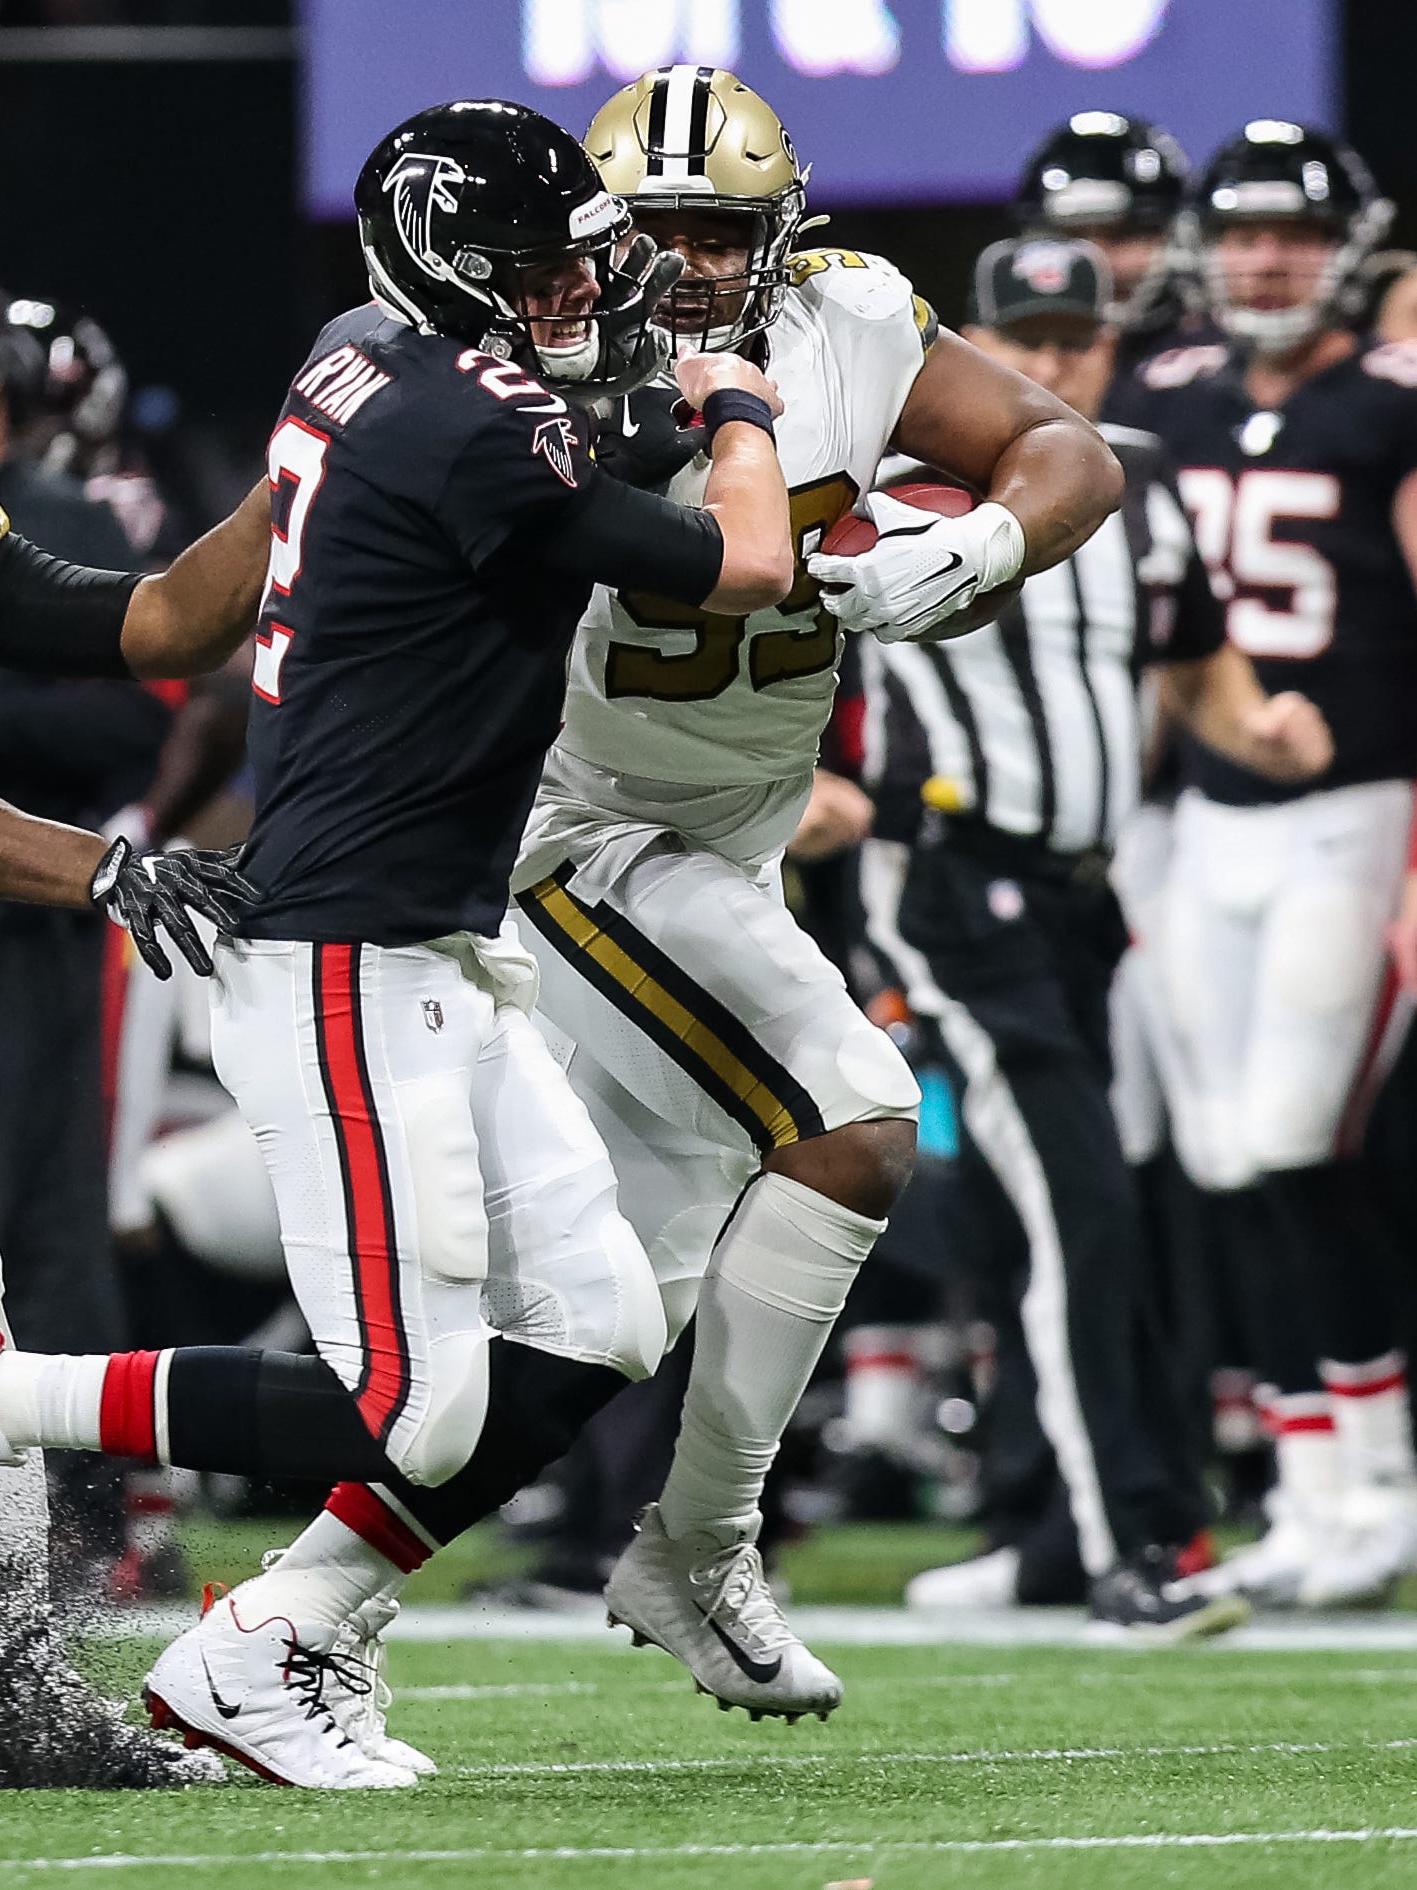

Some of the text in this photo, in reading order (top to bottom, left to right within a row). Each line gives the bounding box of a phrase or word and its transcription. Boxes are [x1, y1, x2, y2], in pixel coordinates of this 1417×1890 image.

[295, 343, 393, 427] RYAN
[454, 347, 550, 401] 2
[1177, 467, 1340, 660] 75
